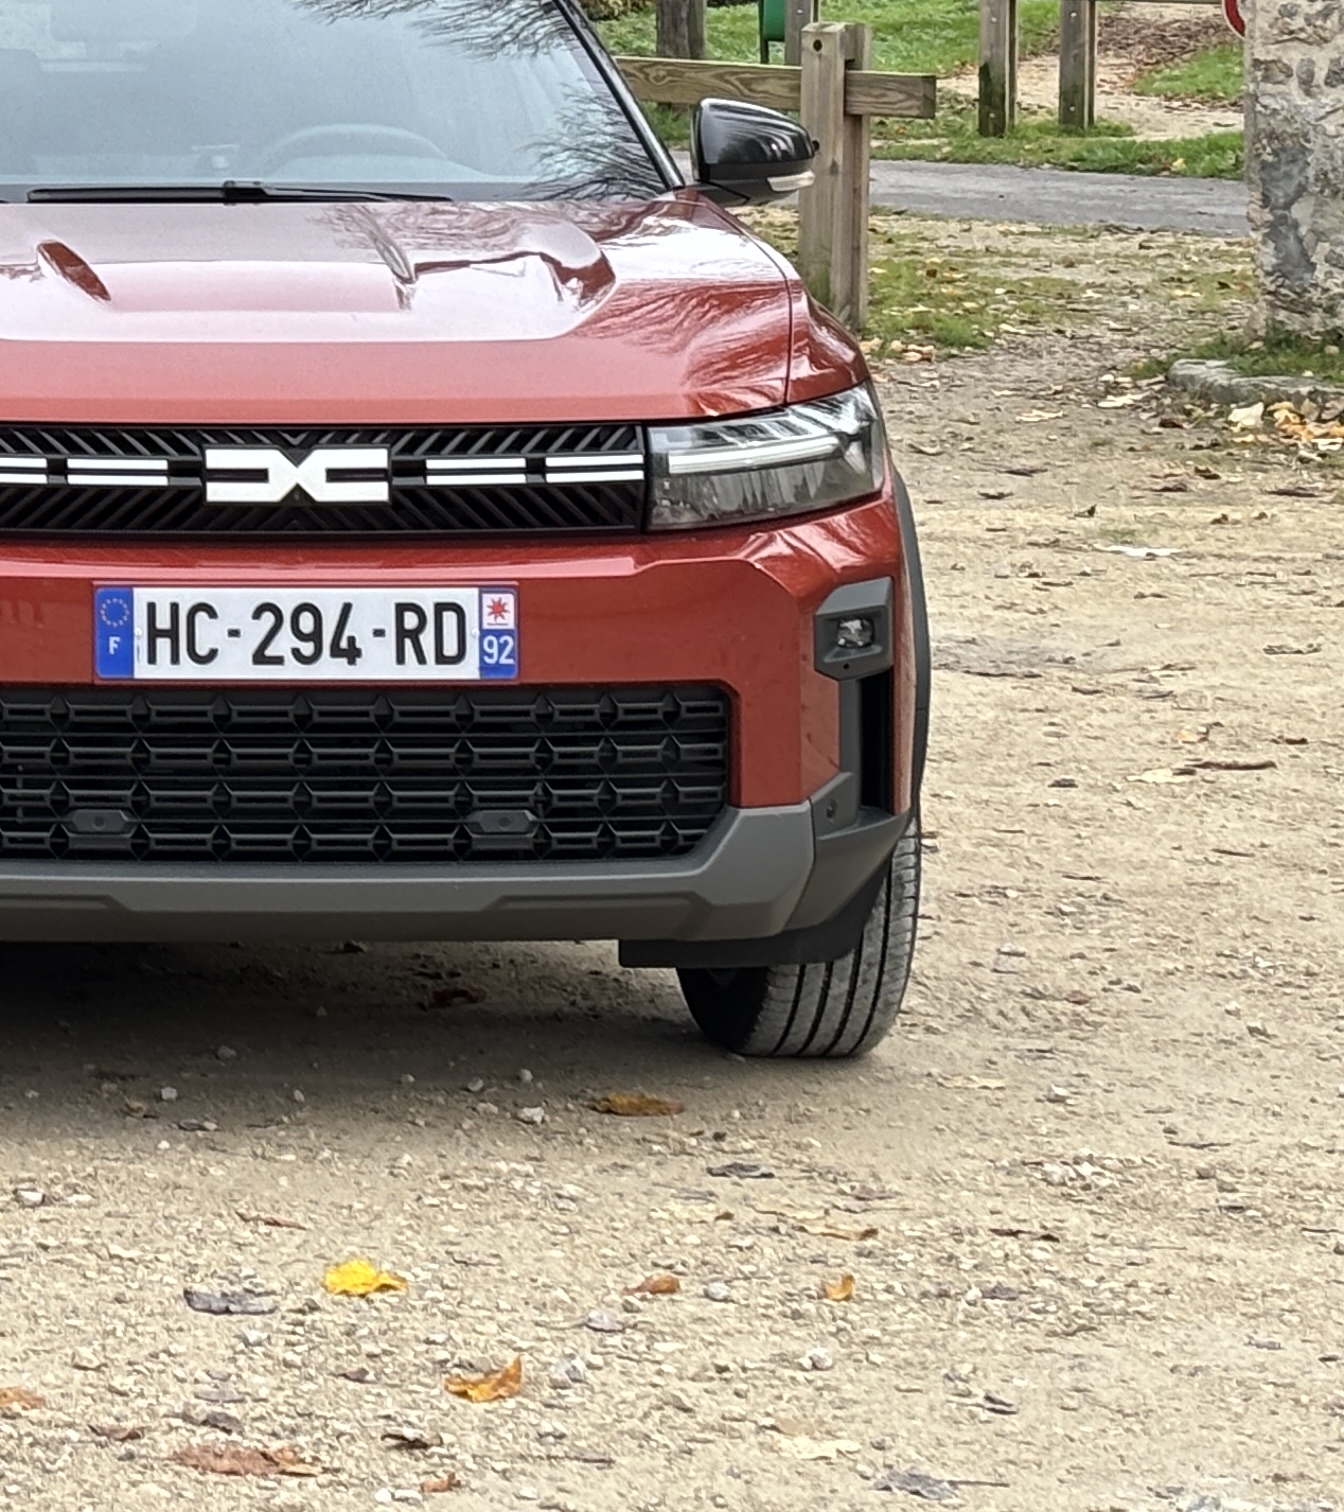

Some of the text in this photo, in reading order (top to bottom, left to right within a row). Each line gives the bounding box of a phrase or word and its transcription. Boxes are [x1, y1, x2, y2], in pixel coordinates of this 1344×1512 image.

[108, 636, 121, 656] F
[146, 601, 467, 666] HC-294-RD
[482, 635, 515, 665] 92
